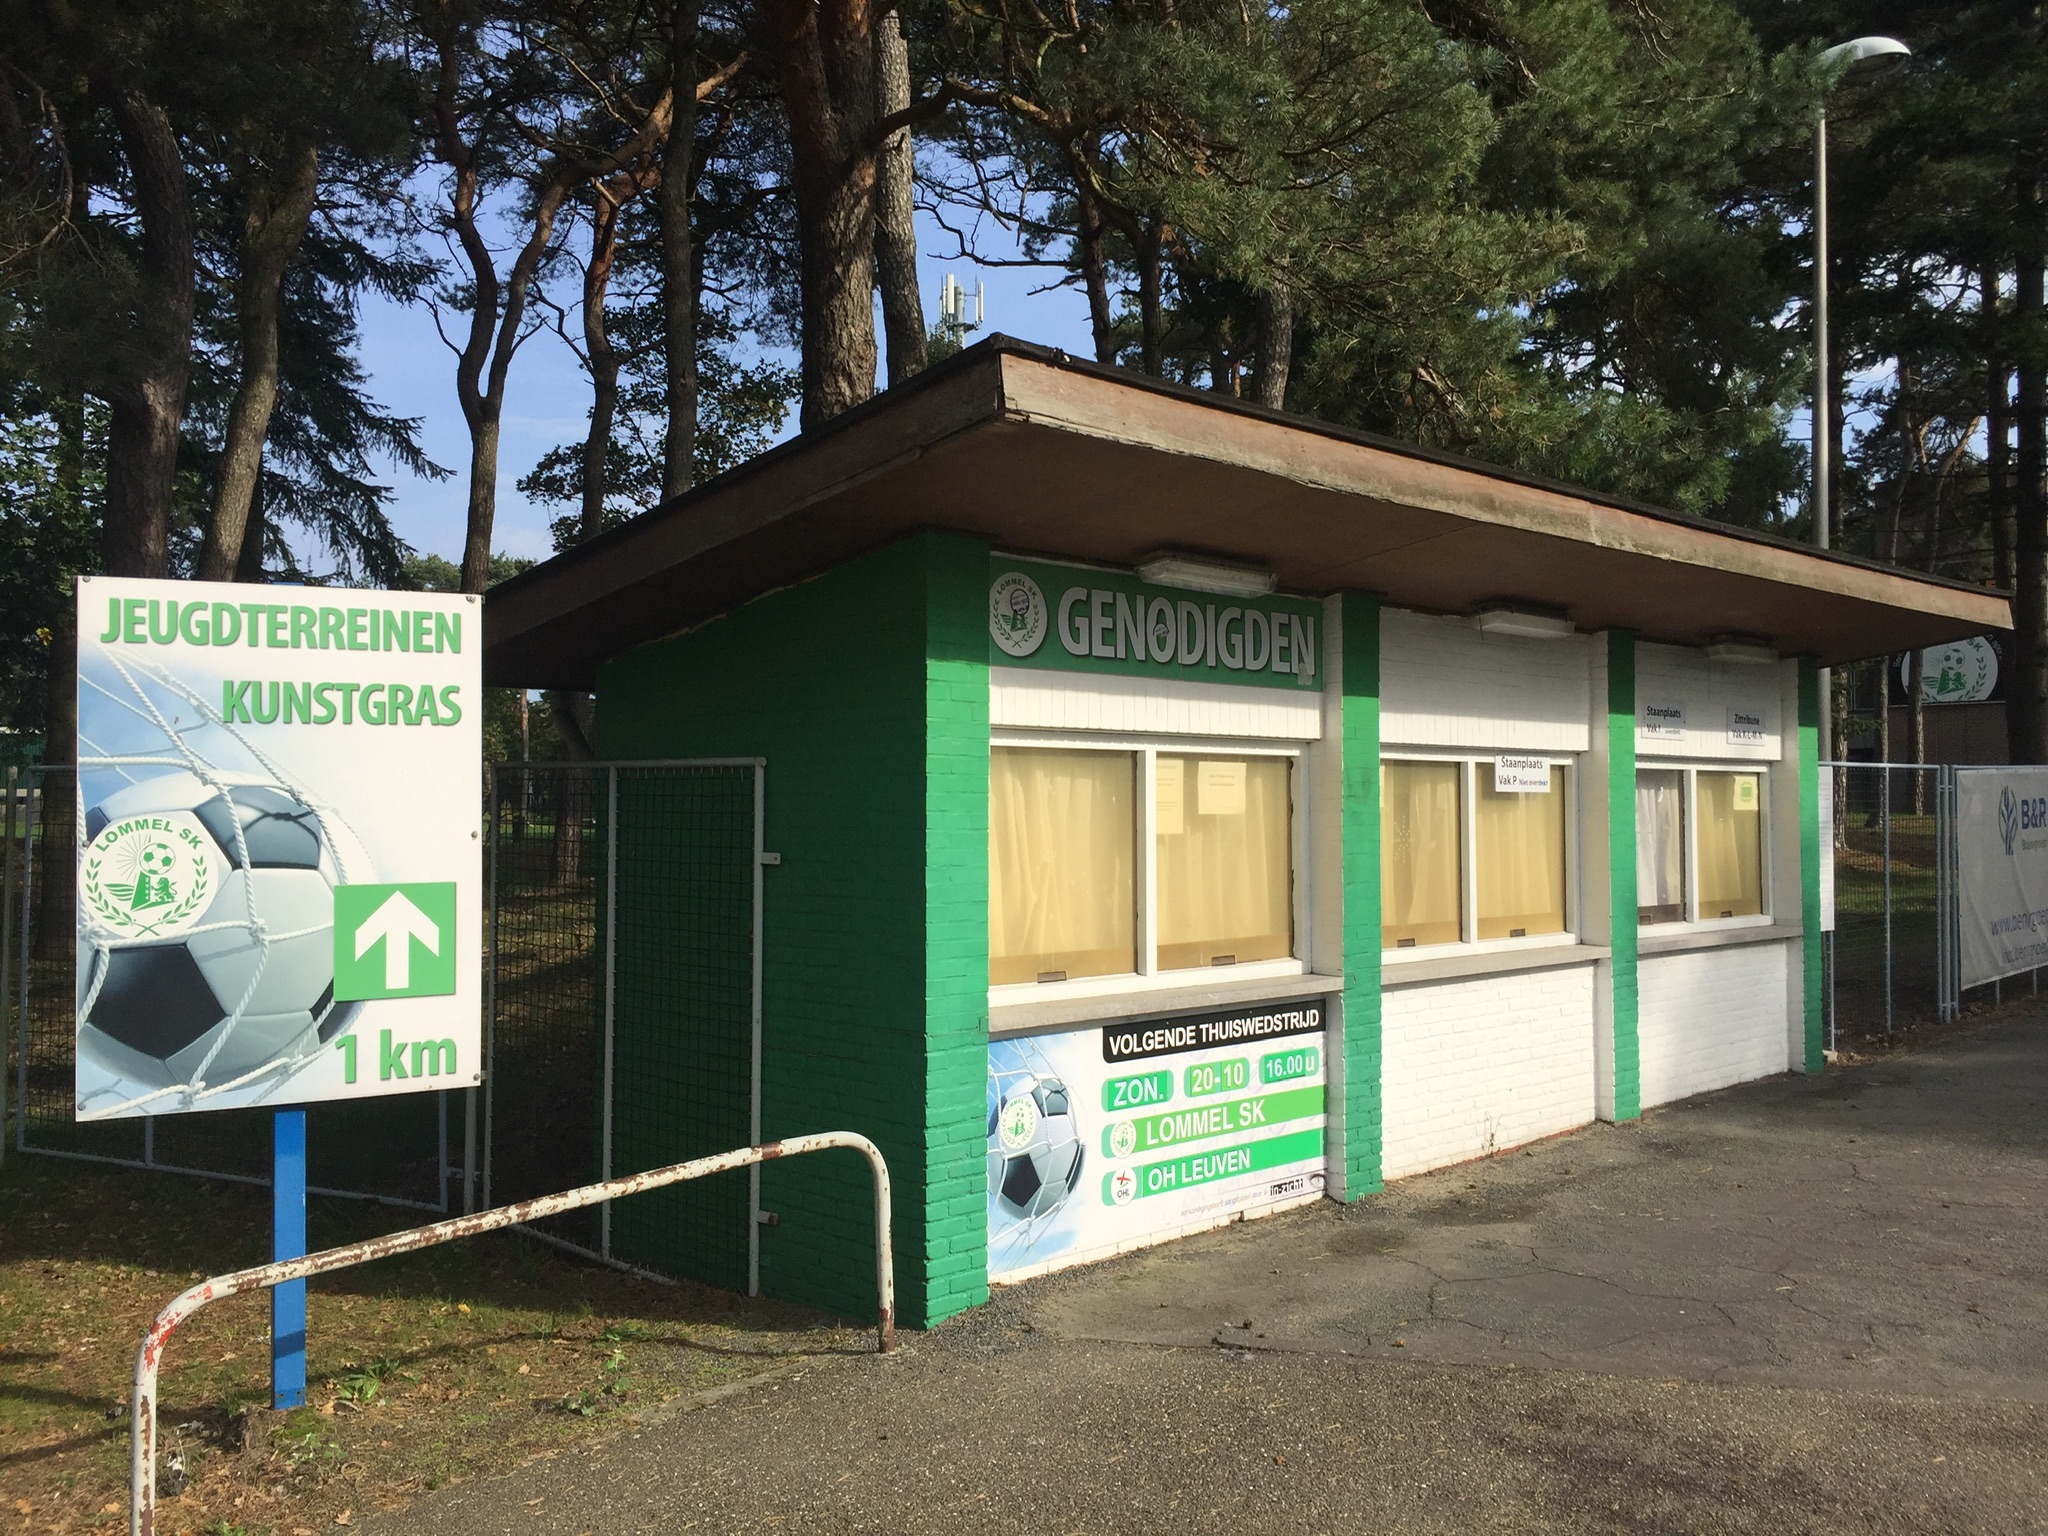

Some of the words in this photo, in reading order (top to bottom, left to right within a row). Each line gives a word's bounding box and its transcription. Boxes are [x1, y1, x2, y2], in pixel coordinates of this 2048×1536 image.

[996, 577, 1026, 596] LOMMEL
[1027, 586, 1038, 599] SK
[101, 597, 462, 654] JEUGDTERREINEN
[1058, 586, 1315, 676] GENODIGDEN
[1966, 637, 1984, 653] SK
[222, 680, 462, 726] KUNSTGRAS
[1647, 705, 1682, 720] Staanplaats
[1498, 774, 1511, 785] Vak
[1512, 775, 1518, 785] P
[1501, 756, 1543, 771] Staanplaats
[2020, 797, 2047, 830] B&R
[95, 819, 173, 852] LOMMEL
[179, 828, 204, 850] SK
[1109, 1026, 1197, 1056] VOLGENDE
[1199, 1008, 1320, 1044] THUISWEDSTRIJD
[335, 1033, 358, 1083] 1
[380, 1029, 457, 1080] km
[1113, 1075, 1165, 1108] ZON.
[1266, 1053, 1302, 1078] 16.00
[1305, 1055, 1315, 1071] u
[1146, 1113, 1234, 1146] LOMMEL
[1239, 1099, 1266, 1126] SK
[1148, 1168, 1176, 1191] OH
[1181, 1148, 1251, 1184] LEUVEN
[1270, 1178, 1304, 1197] in-zicht
